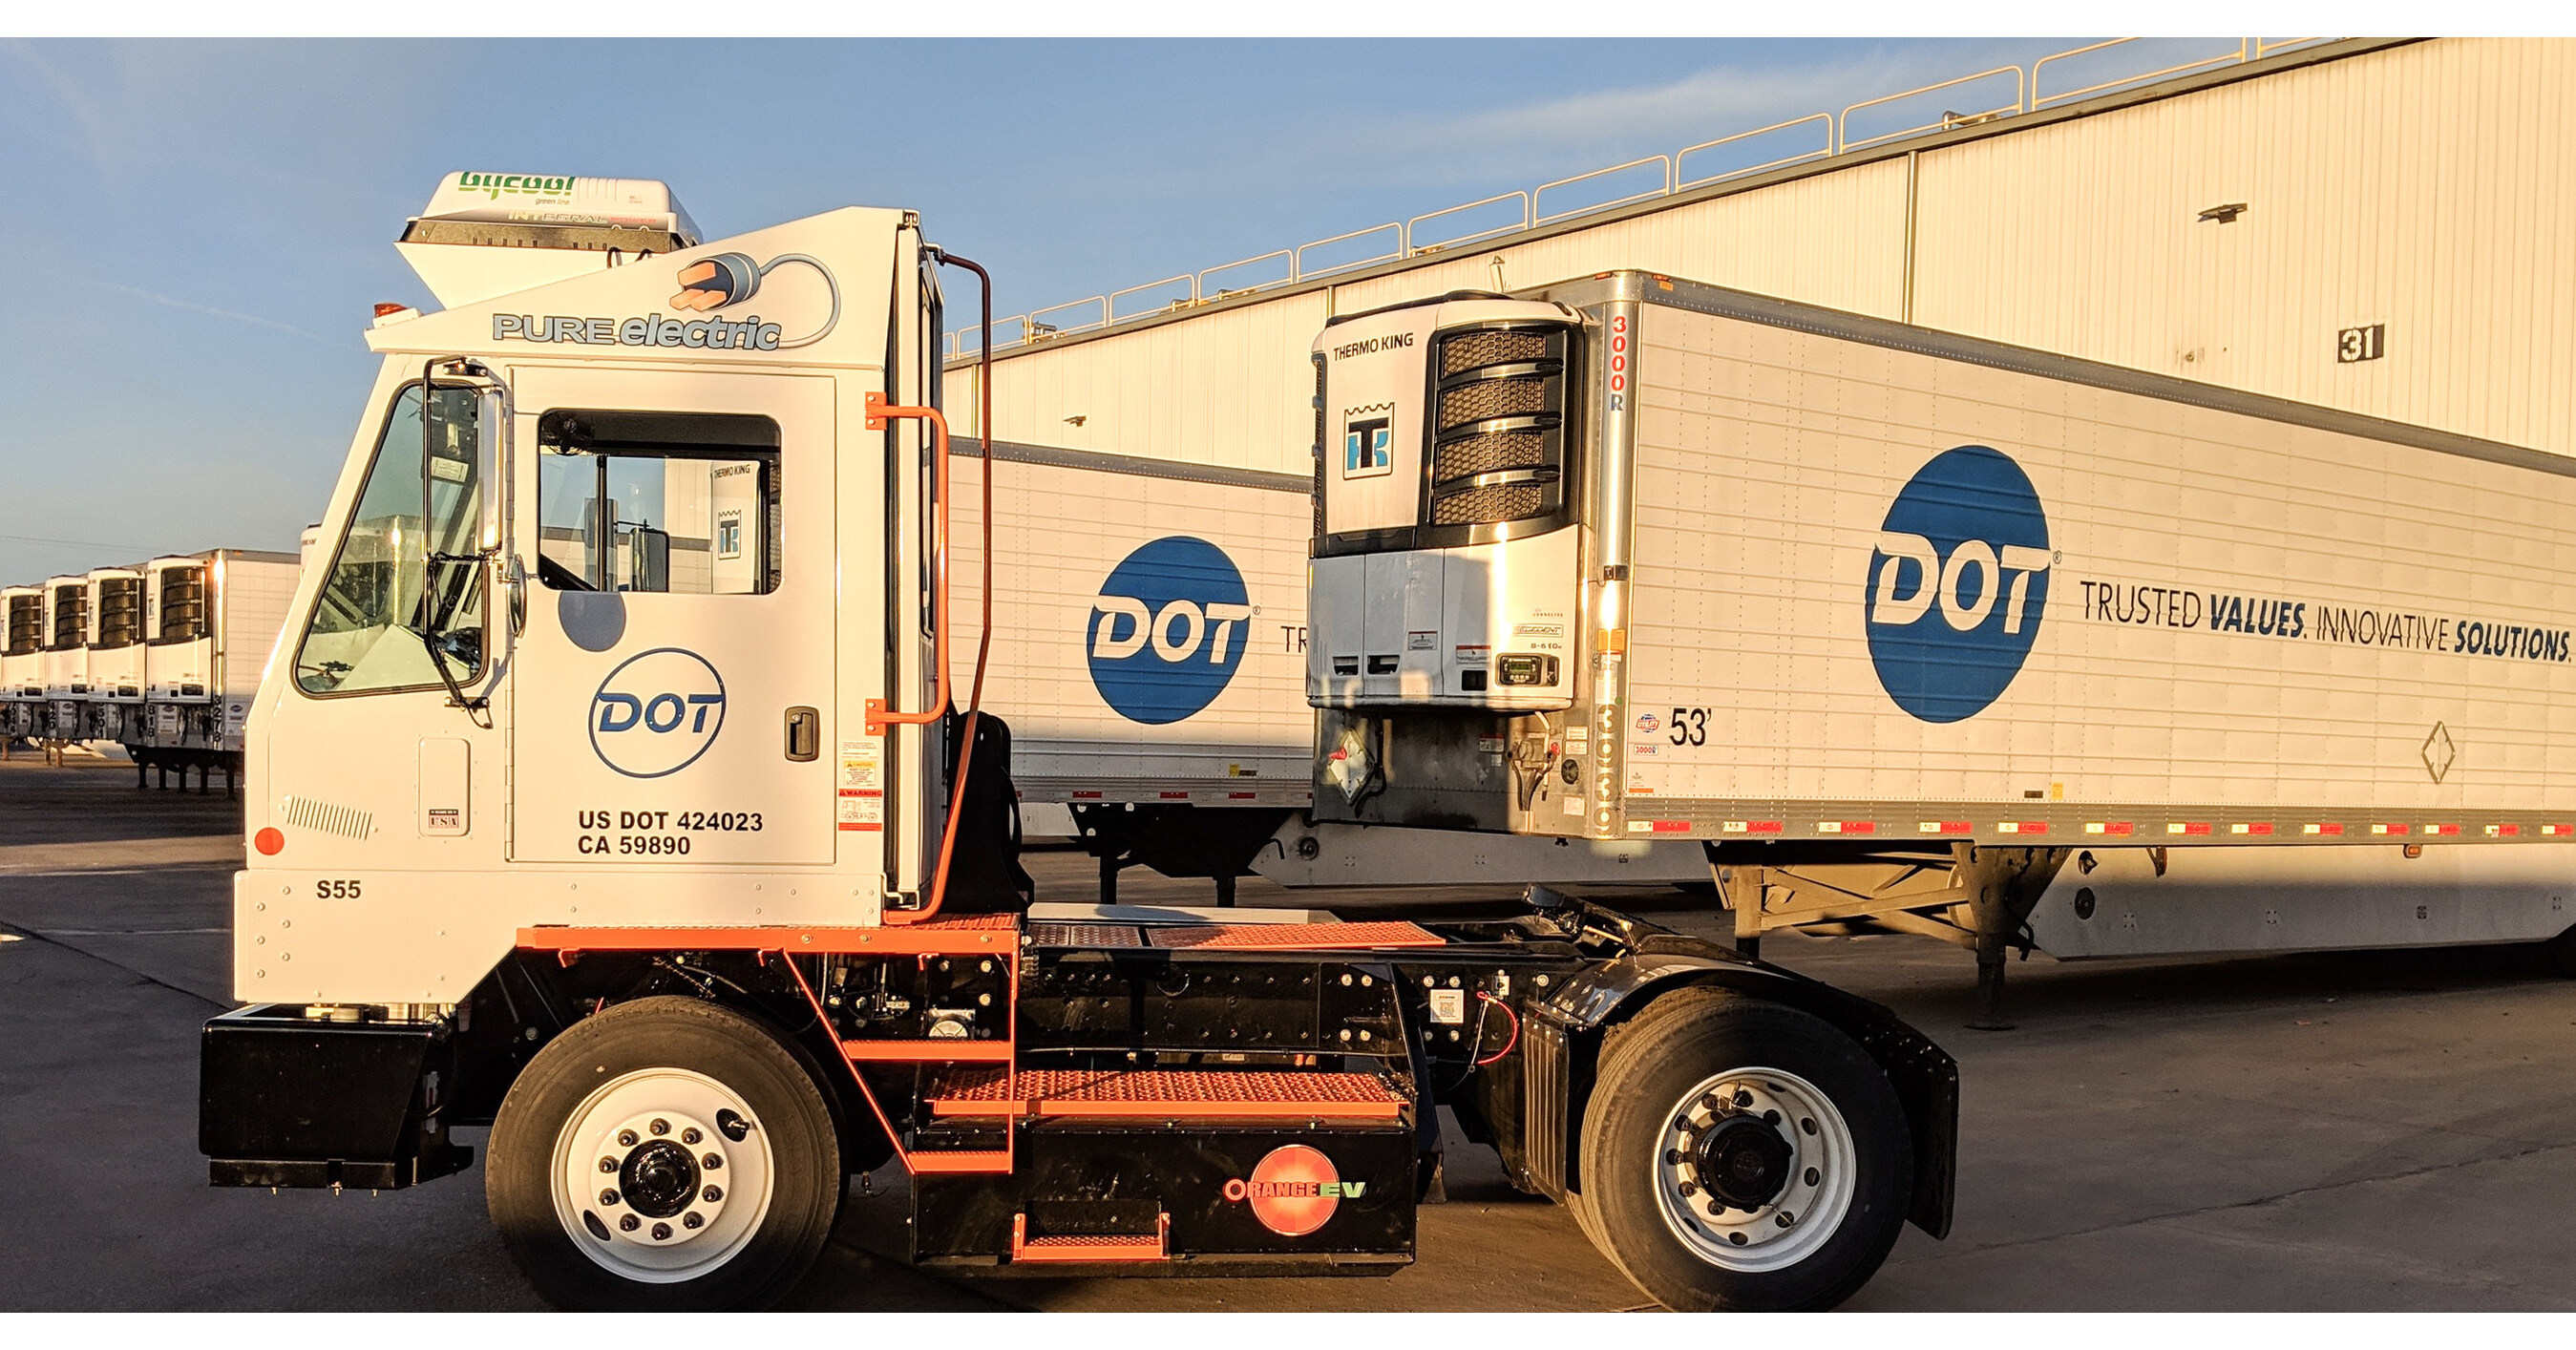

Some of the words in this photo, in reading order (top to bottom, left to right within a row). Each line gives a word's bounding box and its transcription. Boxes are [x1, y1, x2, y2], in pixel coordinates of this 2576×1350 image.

[508, 210, 608, 224] INTEGRAL
[493, 313, 616, 346] PURE
[619, 313, 782, 351] electric
[1333, 338, 1379, 361] THERMO
[1381, 332, 1414, 351] KING
[2341, 327, 2374, 361] 31
[734, 464, 750, 475] KING
[1871, 531, 2051, 634] DOT
[1092, 595, 1251, 664] DOT
[2080, 580, 2202, 628] TRUSTED
[2209, 594, 2308, 640] VALUES.
[2316, 605, 2450, 651] INNOVATIVE
[2454, 621, 2572, 664] SOLUTIONS.
[596, 692, 725, 733] DOT
[579, 811, 611, 830] US
[620, 811, 669, 830] DOT
[677, 812, 763, 832] 424023
[578, 835, 611, 854] CA
[619, 835, 690, 854] 59890
[316, 879, 362, 899] S55
